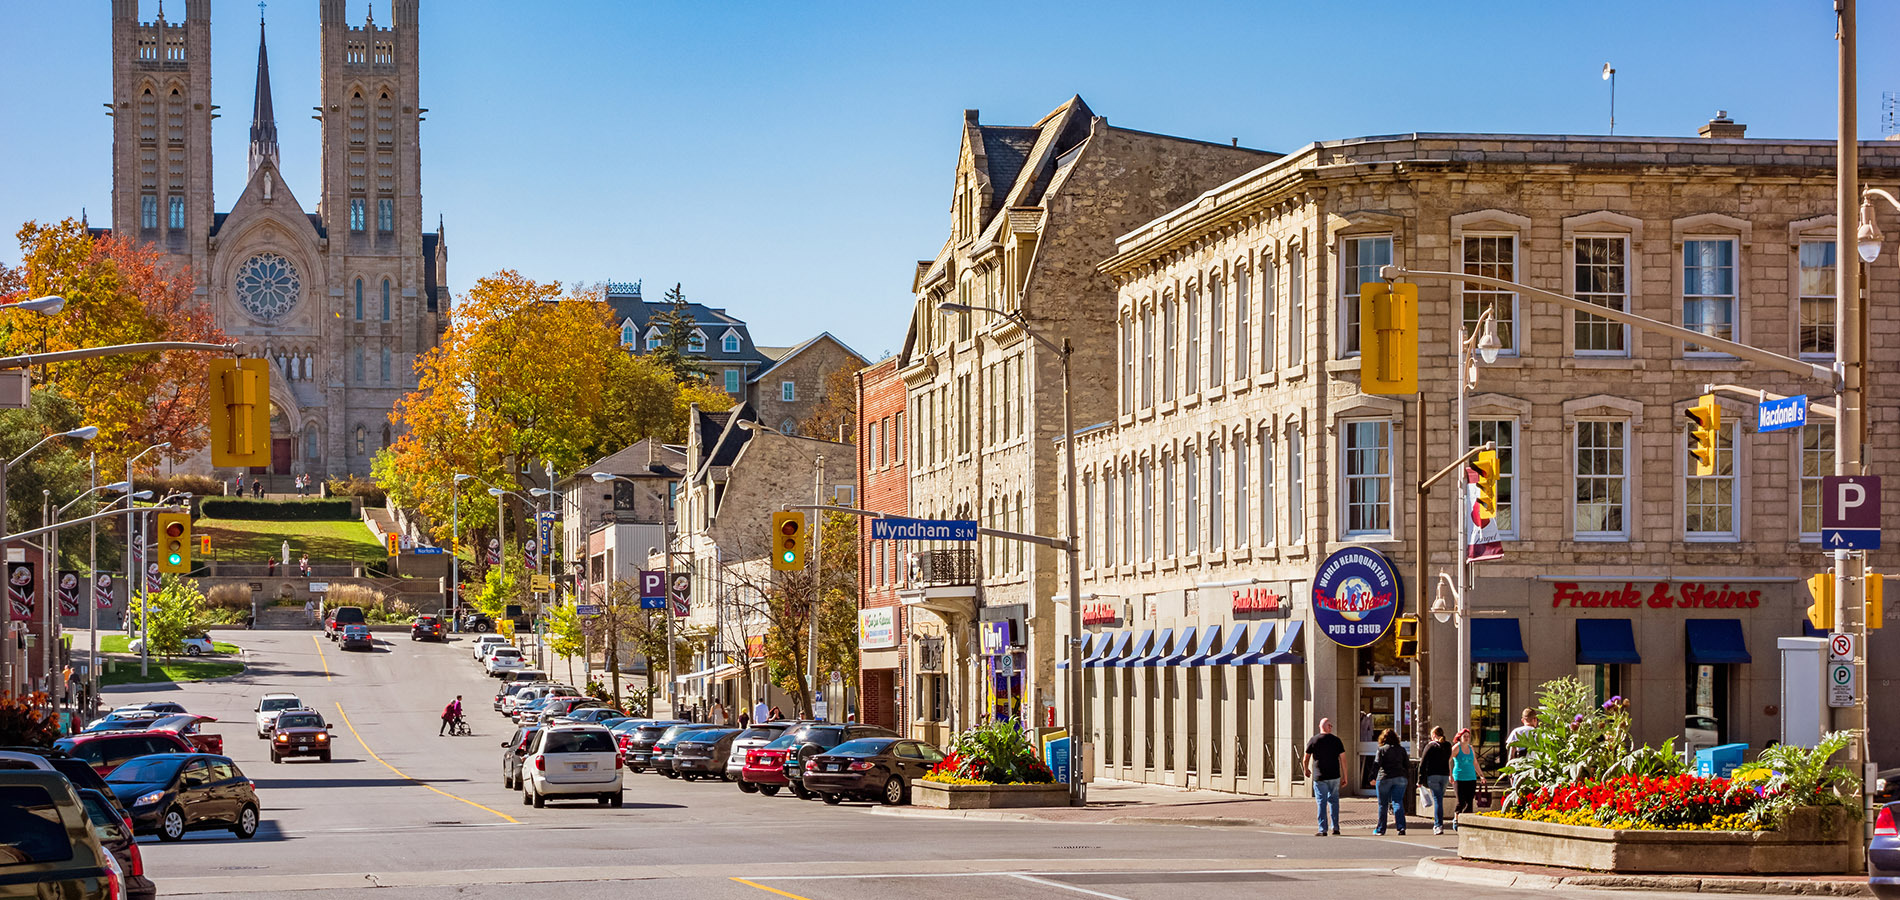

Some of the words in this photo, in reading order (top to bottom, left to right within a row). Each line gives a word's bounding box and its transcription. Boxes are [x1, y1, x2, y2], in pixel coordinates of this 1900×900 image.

[1759, 401, 1797, 427] Macdonell
[1798, 408, 1803, 421] St
[1838, 483, 1866, 521] P
[876, 521, 950, 539] Wyndham
[955, 528, 964, 537] St
[967, 529, 974, 537] N
[1319, 560, 1340, 588] WORLD
[1339, 554, 1389, 588] HEADQUARTERS
[645, 575, 660, 594] P
[1552, 582, 1643, 608] Frank
[1647, 582, 1675, 609] &
[1677, 582, 1761, 608] Steins
[1314, 589, 1348, 611] Frank
[1350, 592, 1358, 612] &
[1359, 591, 1392, 611] Steins
[1329, 624, 1347, 634] PUB
[1349, 624, 1355, 634] &
[1357, 624, 1381, 634] GRUB
